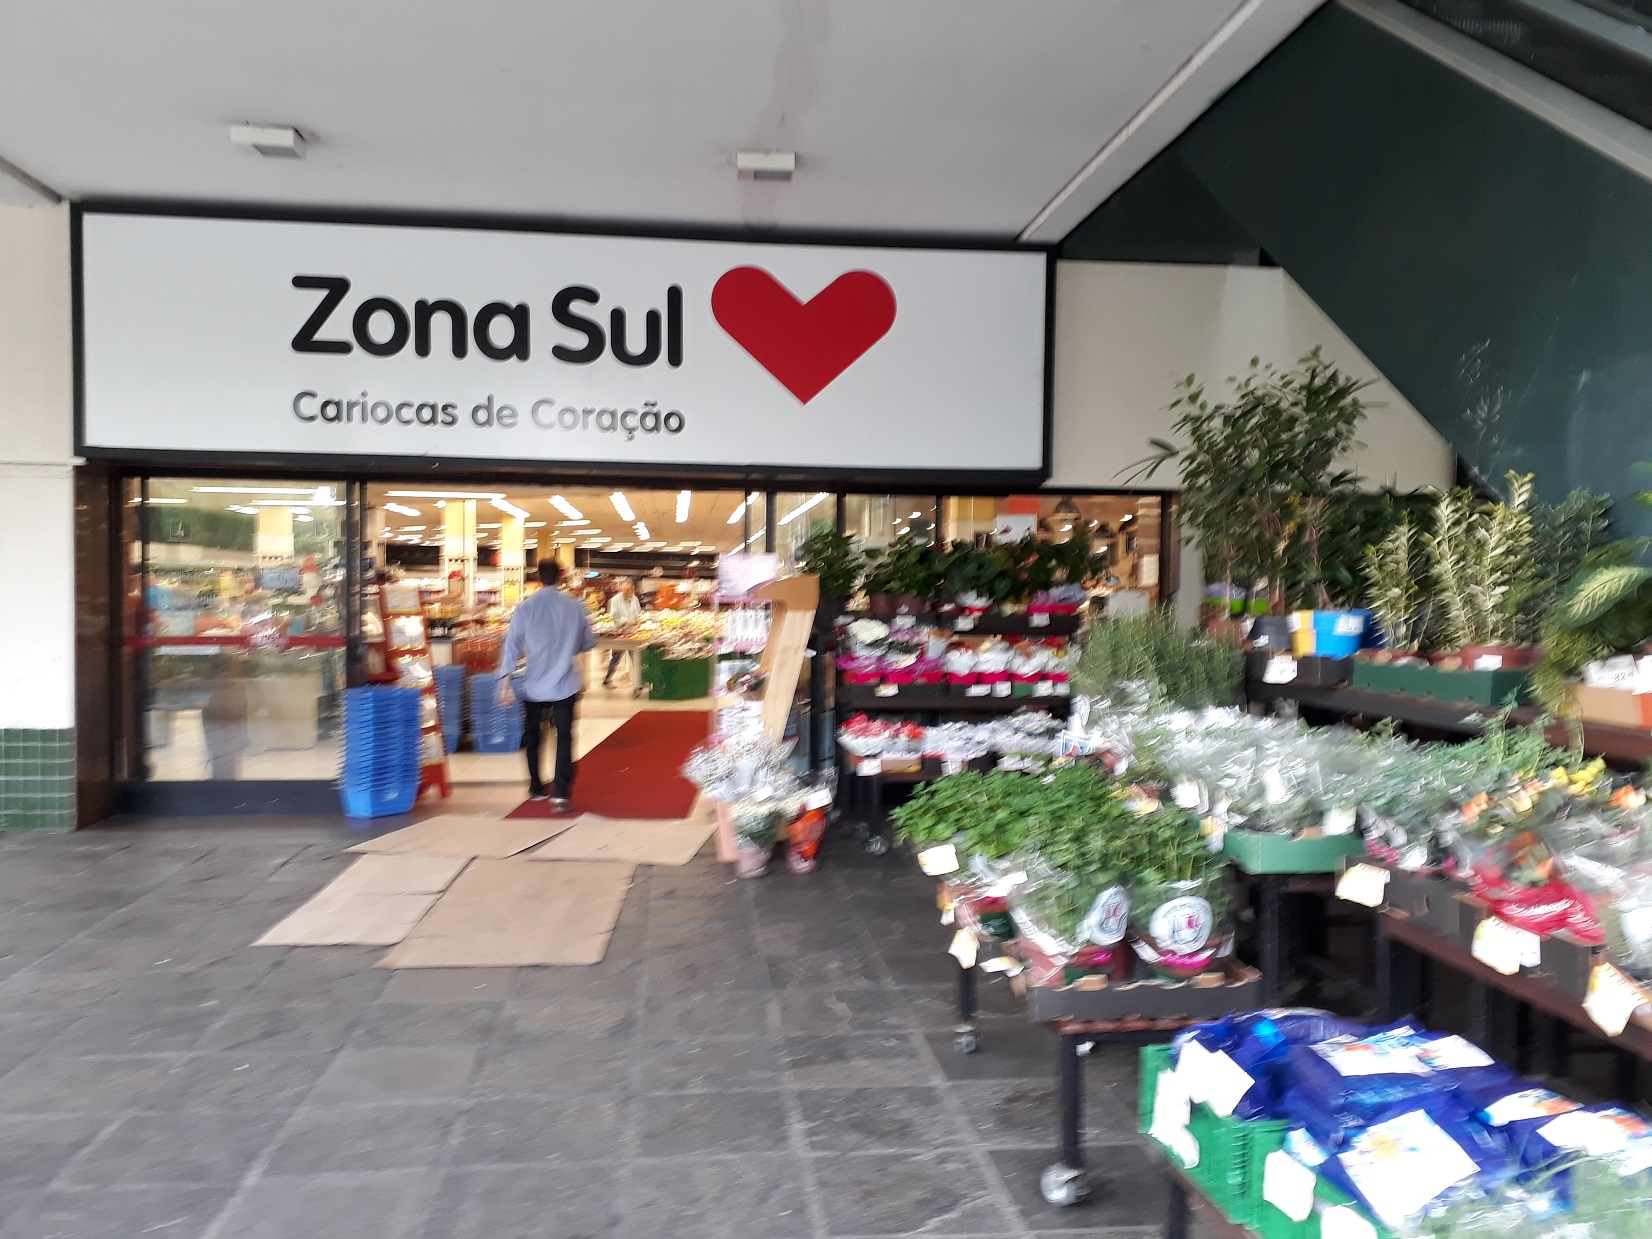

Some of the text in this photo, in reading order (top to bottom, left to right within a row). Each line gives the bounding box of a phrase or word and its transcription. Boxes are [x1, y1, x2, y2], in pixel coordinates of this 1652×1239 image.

[291, 275, 684, 367] Zona Sul
[292, 390, 685, 441] Cariocas de Coração
